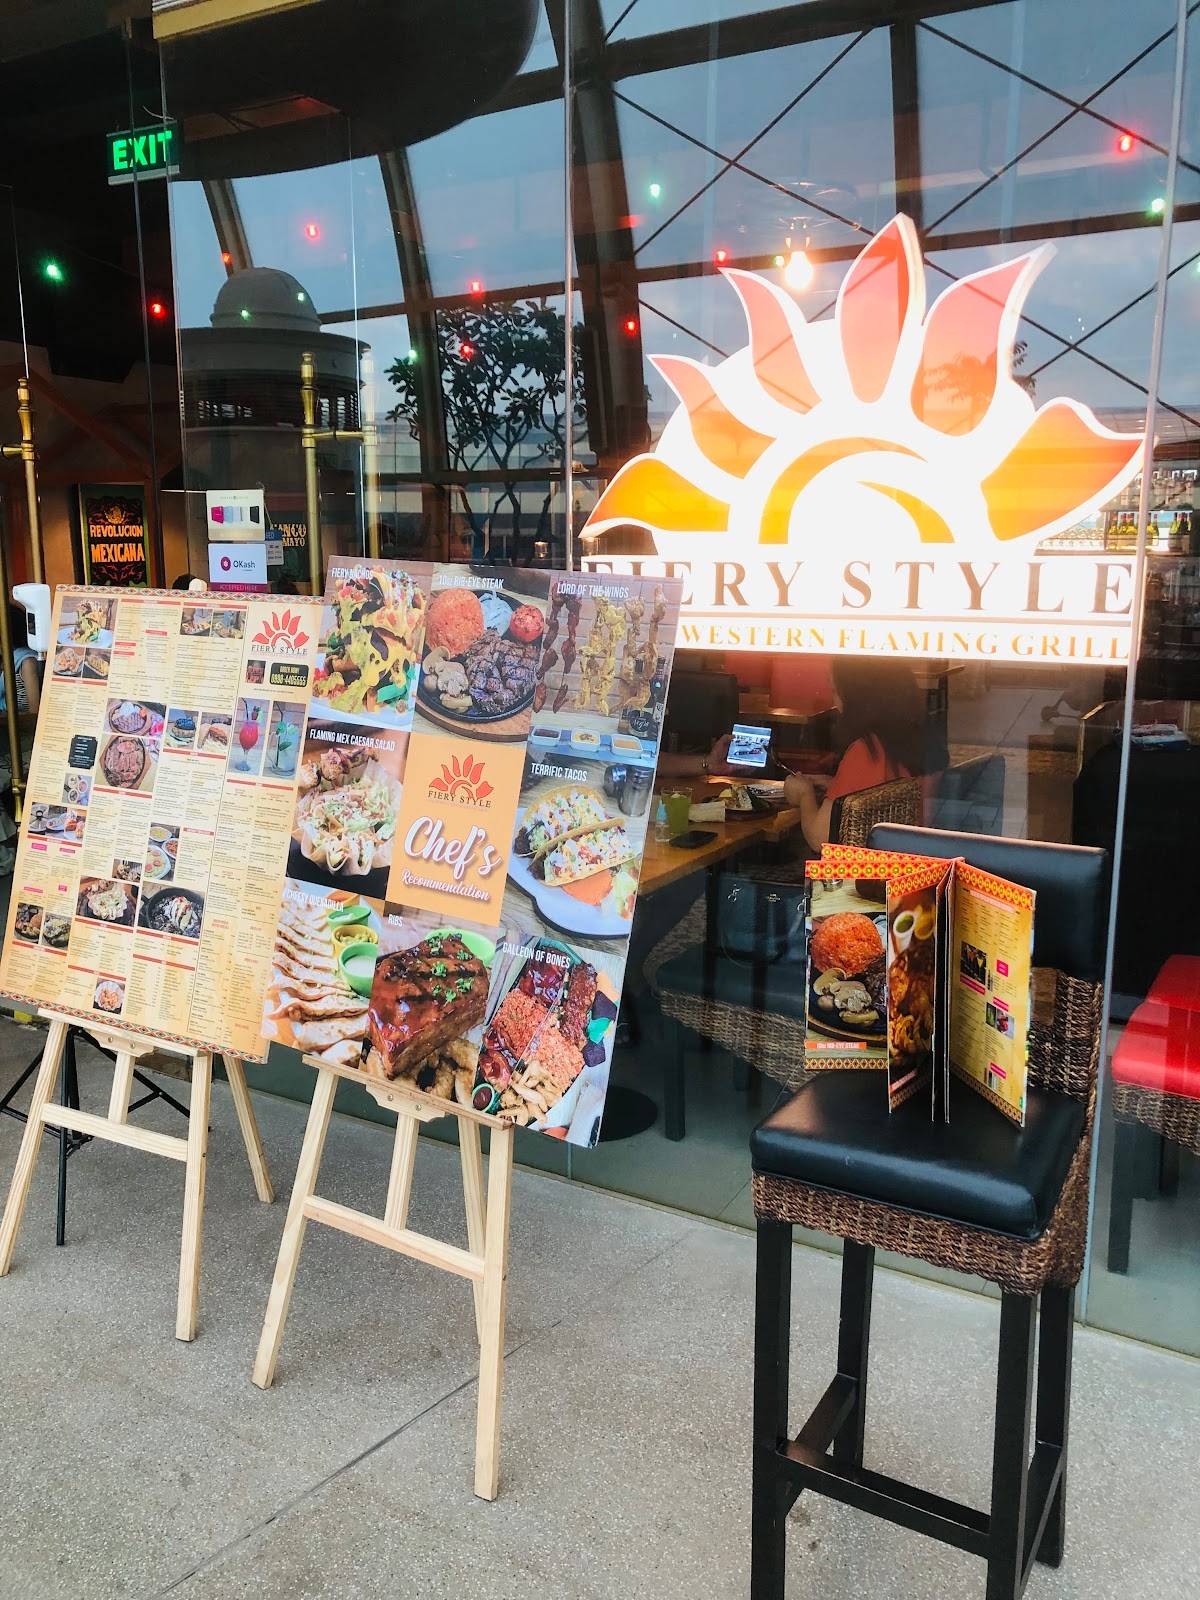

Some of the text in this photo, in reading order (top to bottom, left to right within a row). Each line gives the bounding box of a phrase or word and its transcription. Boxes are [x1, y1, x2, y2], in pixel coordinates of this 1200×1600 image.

[113, 130, 172, 170] EXIT
[89, 525, 143, 537] REVOLUCION
[91, 543, 145, 563] MEXICANA
[331, 568, 348, 578] FIERY
[454, 575, 481, 588] RIB-EYE
[482, 577, 504, 589] STEAK
[557, 582, 630, 598] LORD OF THE WINGS
[842, 561, 1132, 614] STYLE
[251, 645, 308, 656] FIERY STYLE
[680, 624, 1129, 659] WESTERN FLAMING GRILL
[310, 729, 396, 751] FLAMING MEX CAESAR SALAD
[531, 762, 588, 782] TERRIFIC TACOS
[428, 790, 456, 802] FIERY
[460, 795, 492, 808] STYLE
[403, 816, 502, 880] Chef's
[402, 869, 491, 901] Recommendation
[388, 913, 403, 927] RIBS
[502, 942, 571, 969] GALLEON OF BONES
